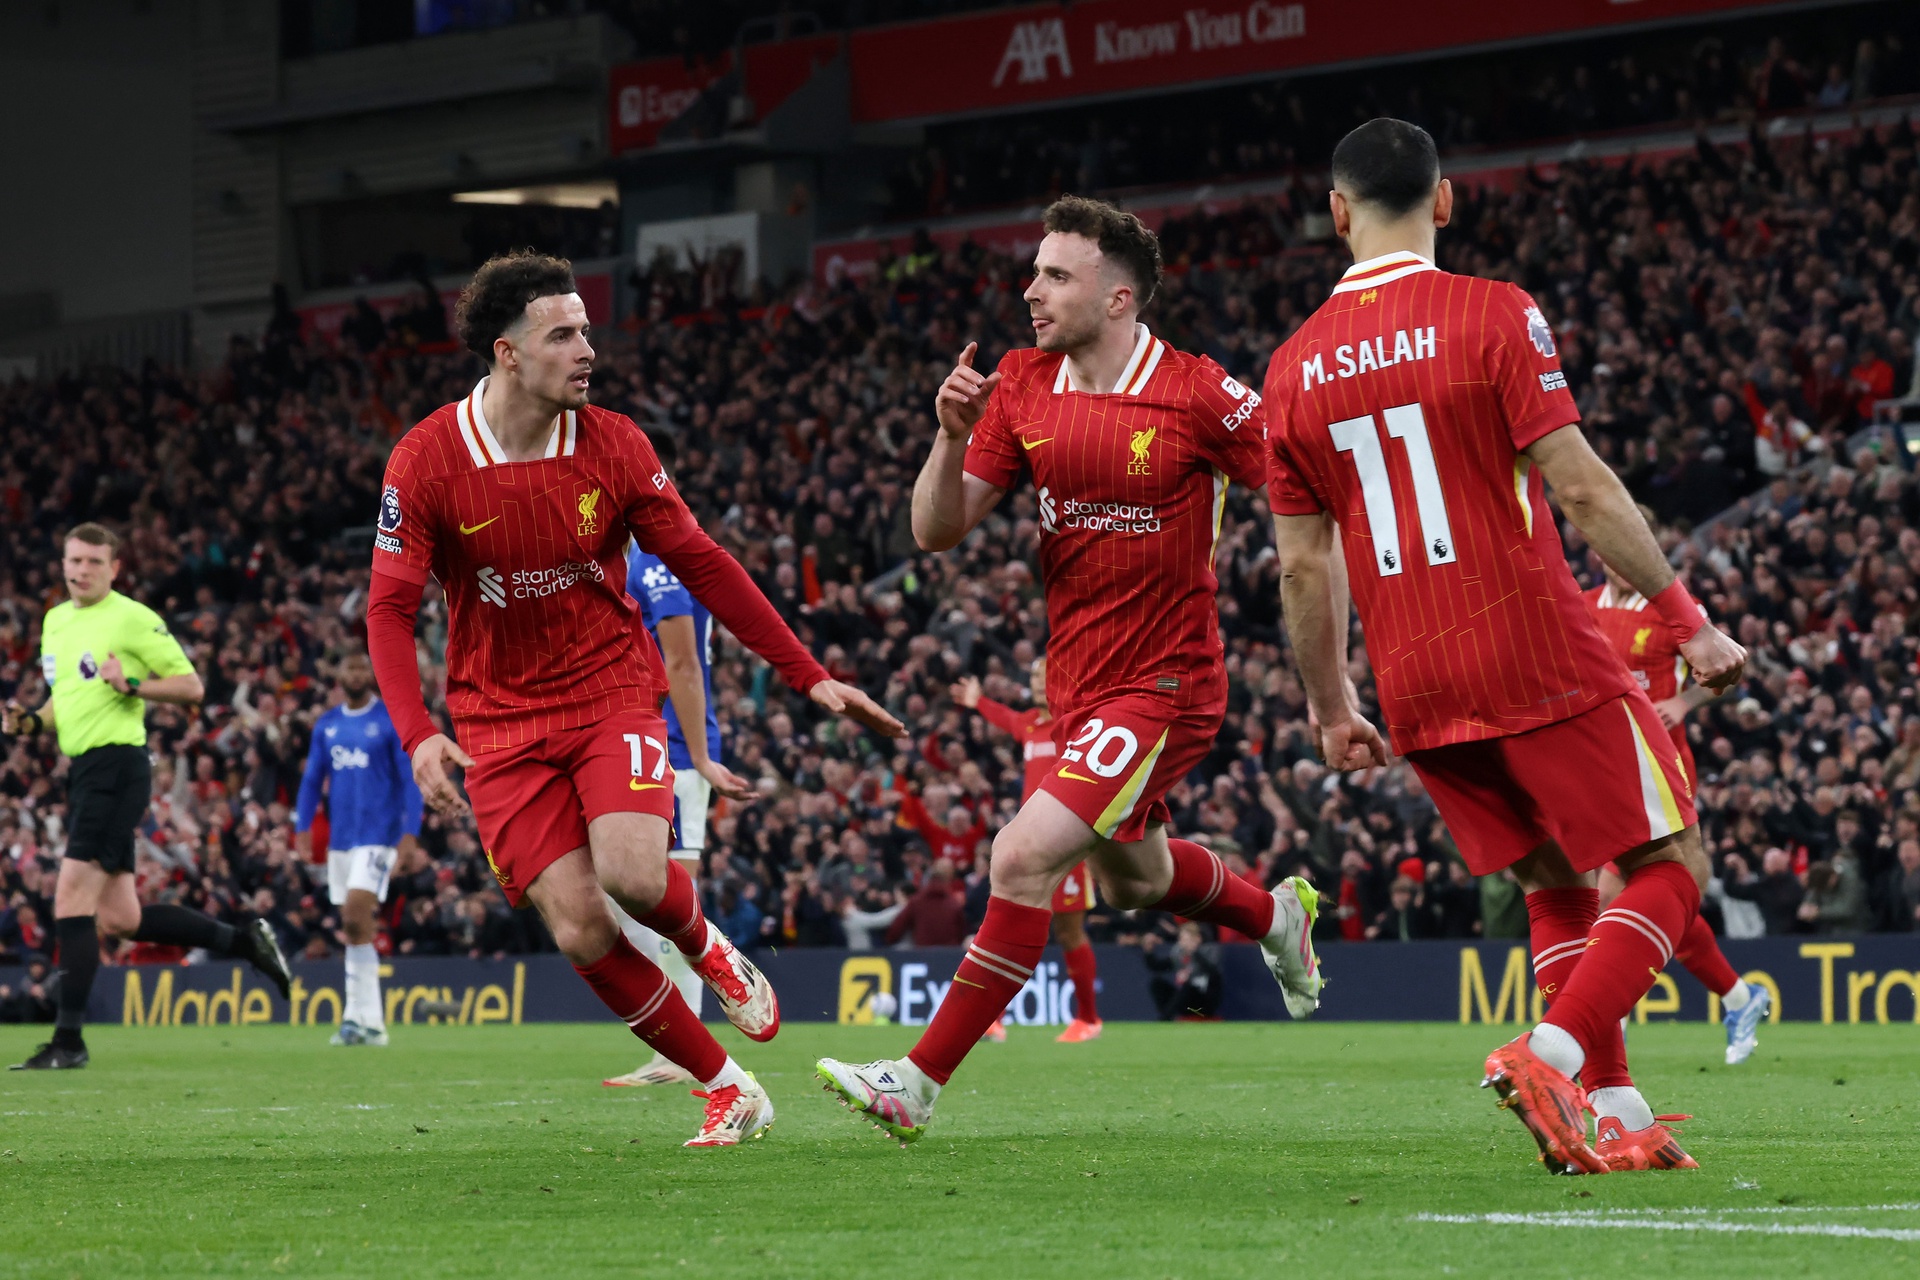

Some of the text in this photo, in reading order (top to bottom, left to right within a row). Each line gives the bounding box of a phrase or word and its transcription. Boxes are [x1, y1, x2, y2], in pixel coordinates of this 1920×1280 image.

[993, 18, 1073, 87] AXA
[1094, 1, 1306, 65] Know You Can
[1063, 498, 1154, 520] standard
[1327, 402, 1457, 577] 11
[1064, 515, 1161, 533] chartered
[511, 559, 599, 585] standard
[513, 566, 605, 599] chartered
[622, 733, 667, 782] 17
[1061, 718, 1139, 778] 20
[122, 966, 273, 1026] Made
[378, 961, 526, 1026] ravel
